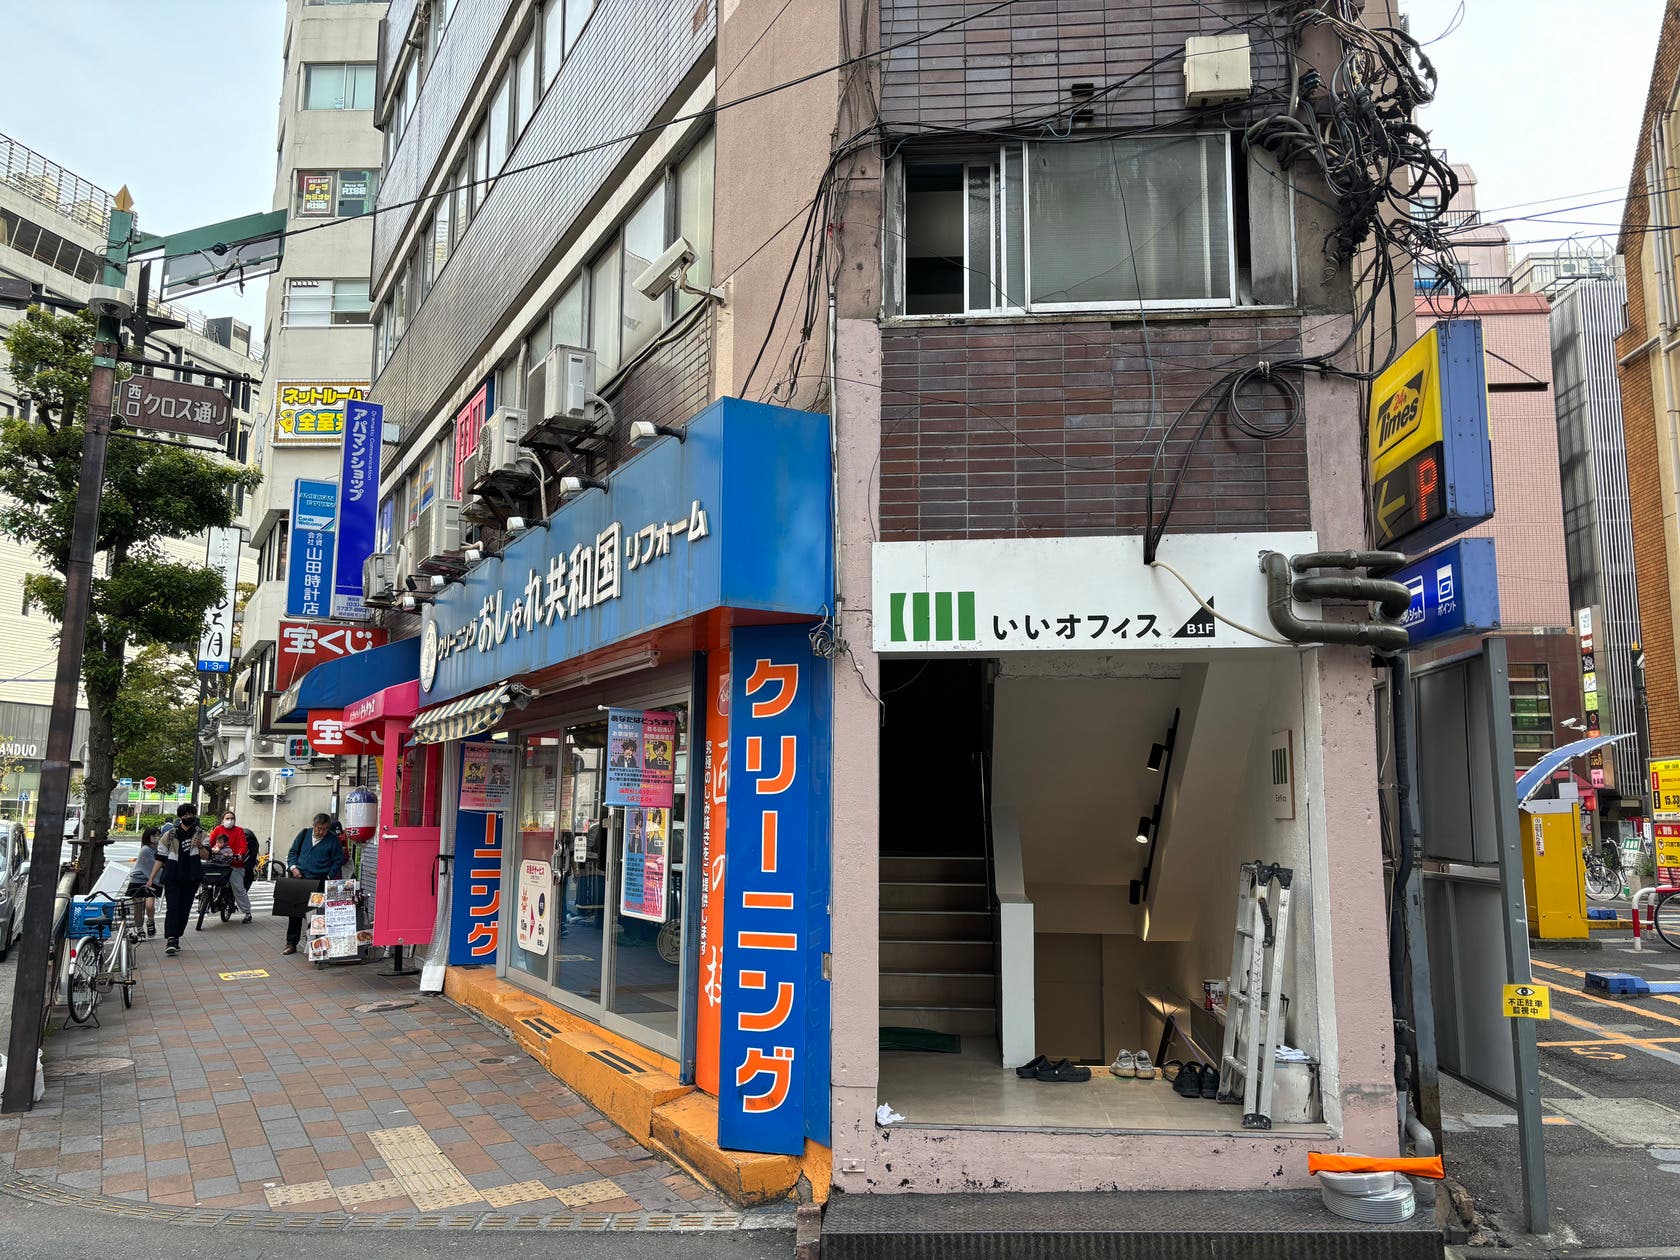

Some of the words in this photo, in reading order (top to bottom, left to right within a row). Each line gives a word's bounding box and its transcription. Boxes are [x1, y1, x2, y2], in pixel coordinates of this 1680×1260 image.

[341, 187, 367, 195] RISE
[143, 393, 228, 426] クロス通り
[283, 386, 364, 406] ネットルーム
[1378, 395, 1420, 449] Times
[348, 407, 369, 502] アパマンショップ
[1418, 457, 1438, 522] P
[626, 500, 709, 571] リフォーム
[302, 547, 323, 616] 山田時計店
[478, 521, 622, 653] おしゃれ共和国
[1437, 600, 1457, 617] ポイント
[283, 627, 373, 655] 宝くじ
[438, 617, 479, 661] クリーニング
[993, 614, 1162, 641] いいオフィス
[1186, 623, 1214, 635] B1F
[203, 661, 224, 671] 1-3F
[736, 658, 799, 1114] クリーニング
[1508, 998, 1543, 1008] 不正駐車
[1512, 1006, 1539, 1016] 監視中
